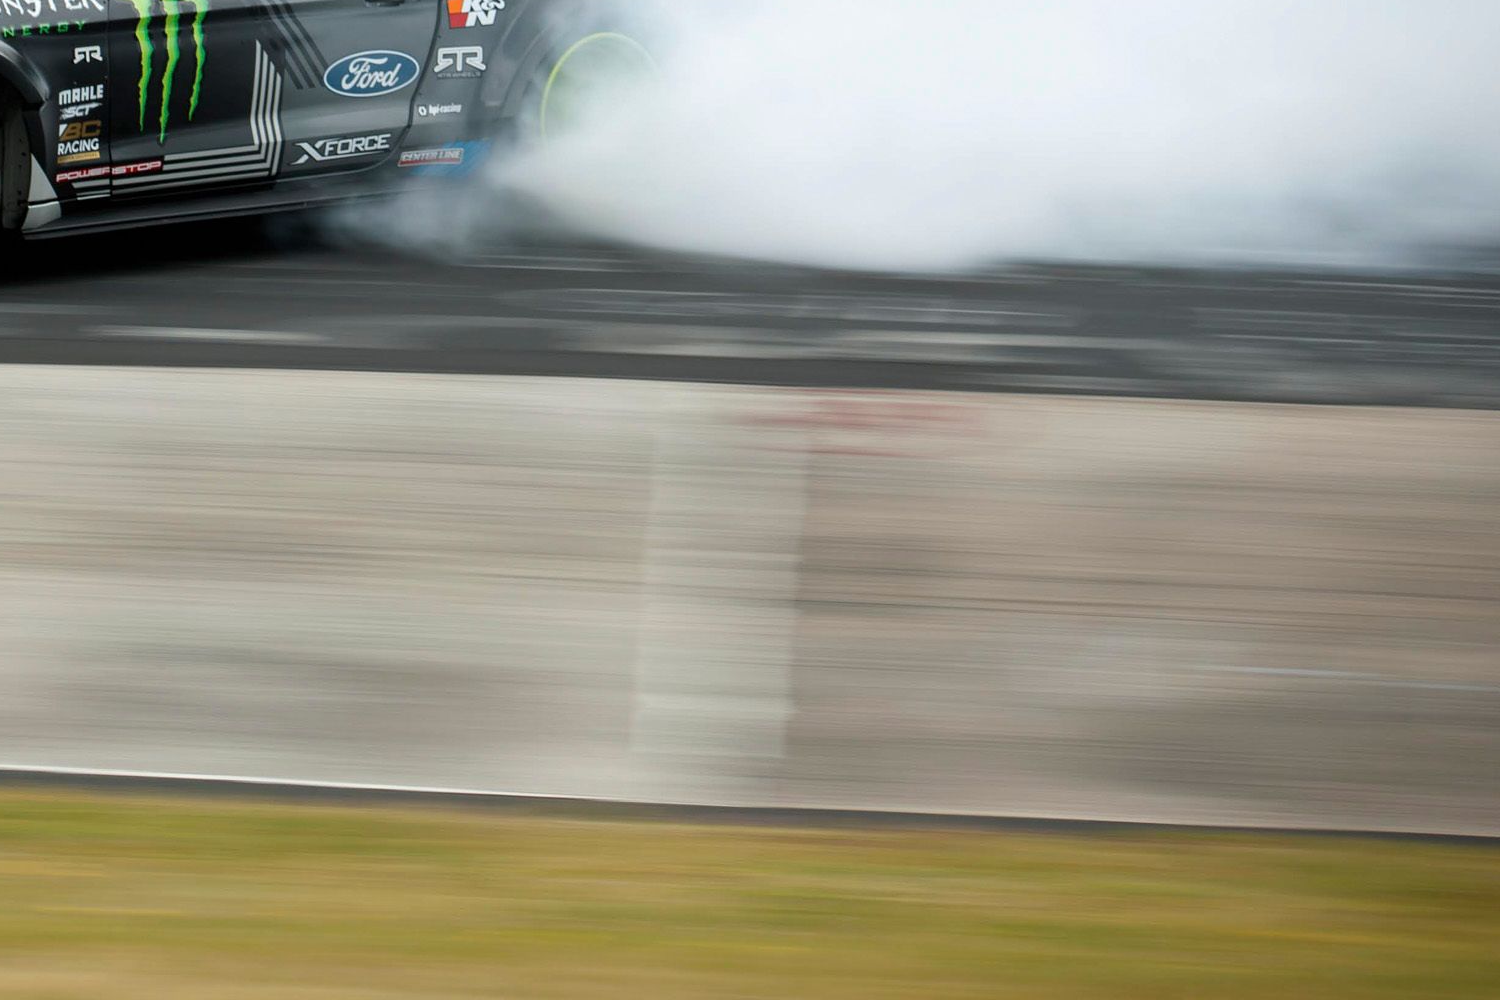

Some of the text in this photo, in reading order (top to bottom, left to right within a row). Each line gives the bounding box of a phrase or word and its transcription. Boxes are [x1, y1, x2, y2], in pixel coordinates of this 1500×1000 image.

[341, 56, 402, 90] Ford
[59, 84, 104, 105] MAHLE
[60, 102, 102, 120] SCT
[59, 120, 102, 141] BC
[57, 138, 99, 155] RACING
[290, 133, 392, 165] XFORCE
[399, 149, 462, 162] CENTER LINE
